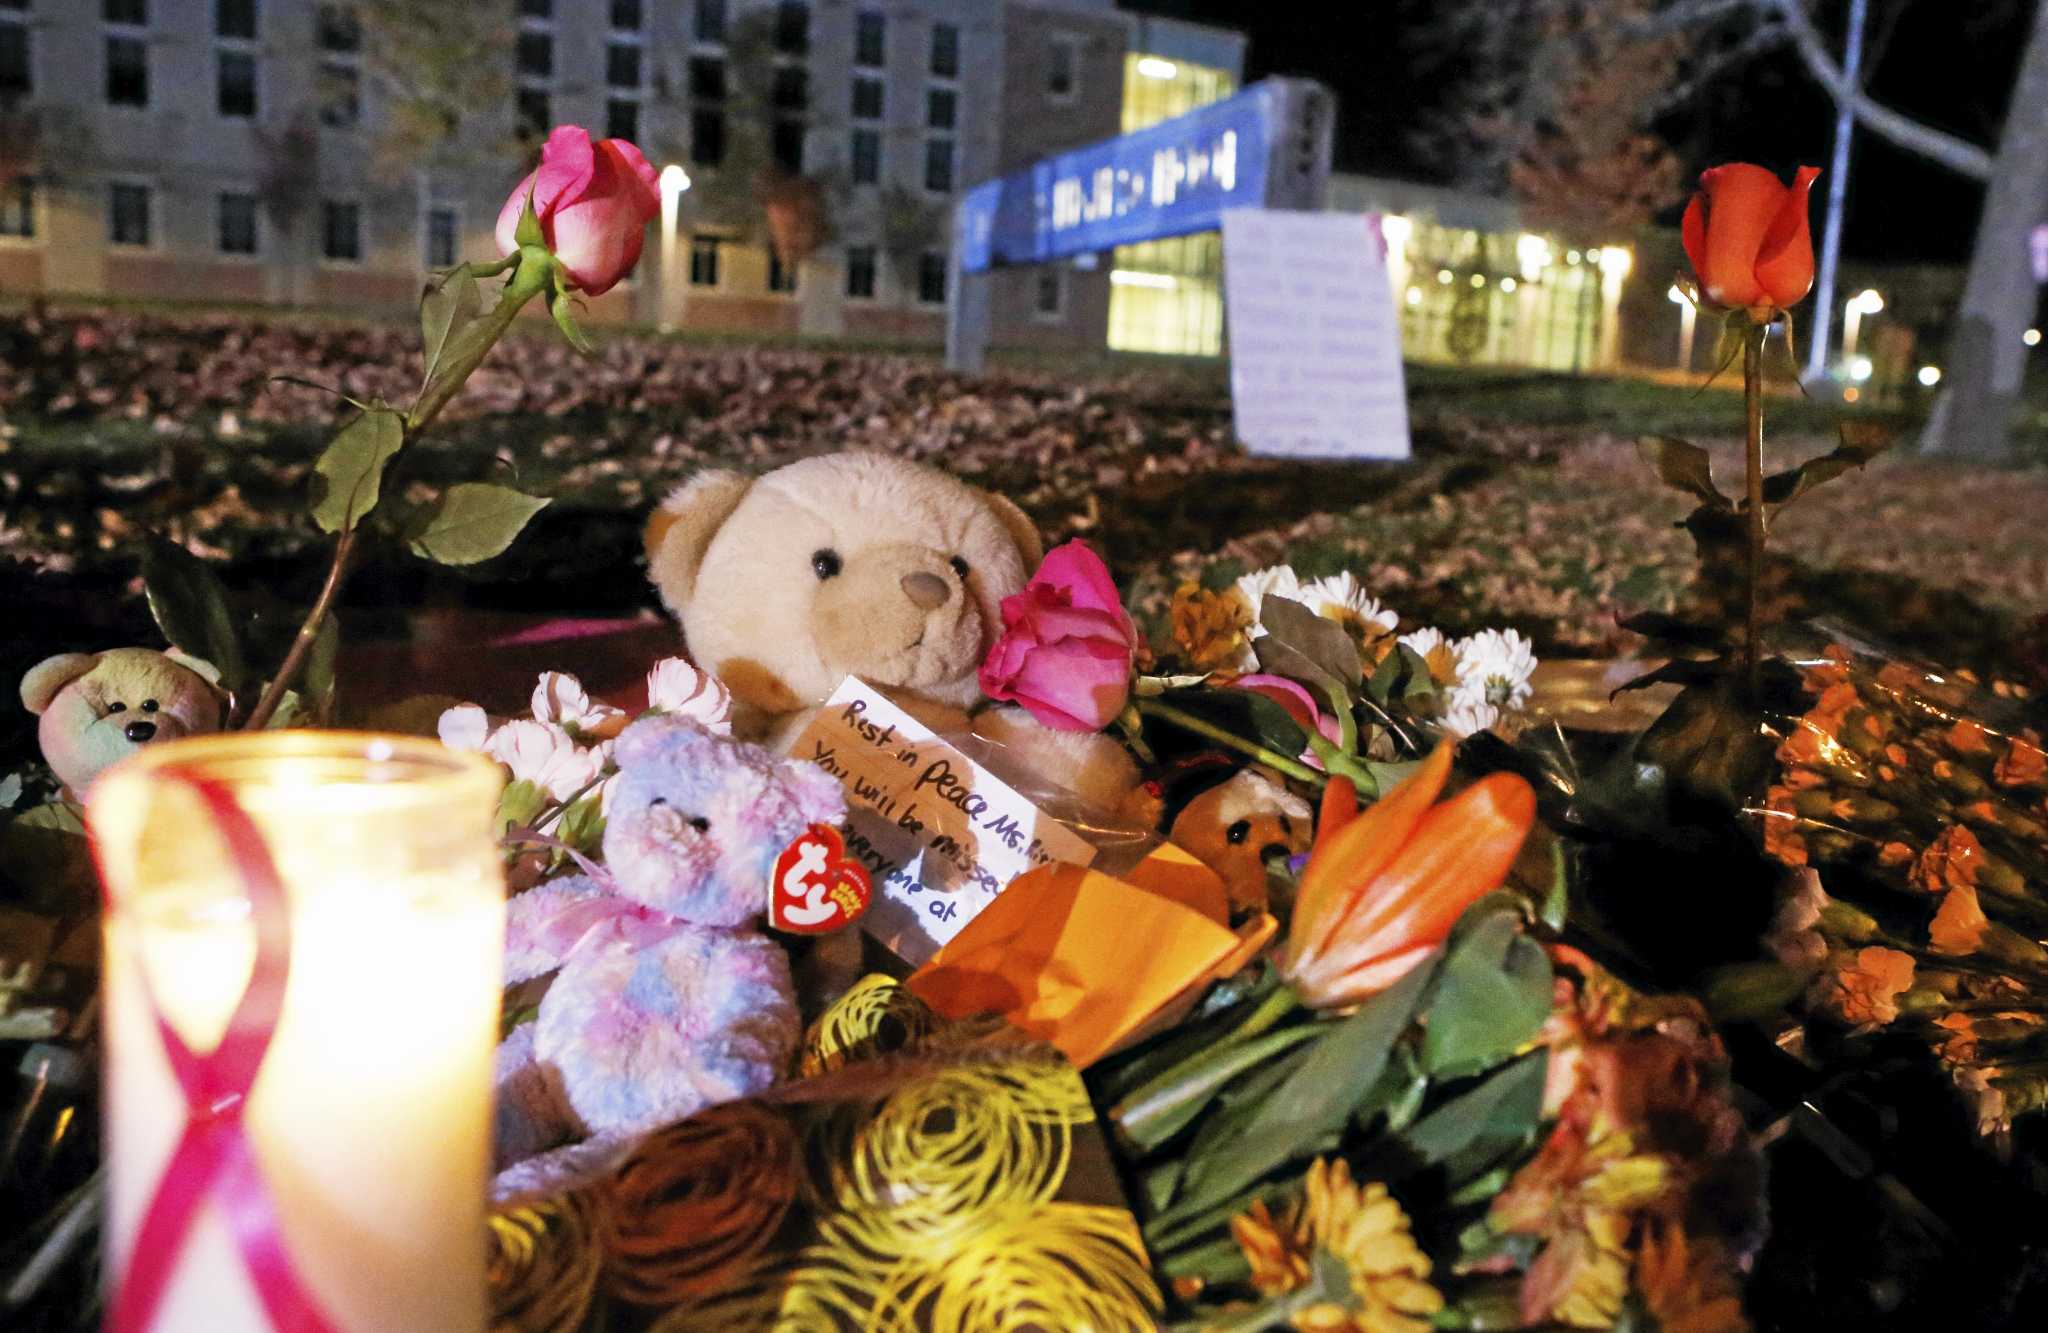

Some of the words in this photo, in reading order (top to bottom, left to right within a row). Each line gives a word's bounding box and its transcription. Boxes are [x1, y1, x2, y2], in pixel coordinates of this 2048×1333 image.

[842, 699, 896, 746] Rest
[896, 744, 918, 768] in
[812, 740, 848, 778] You
[854, 776, 896, 816] will
[898, 803, 924, 835] be
[929, 900, 957, 921] at
